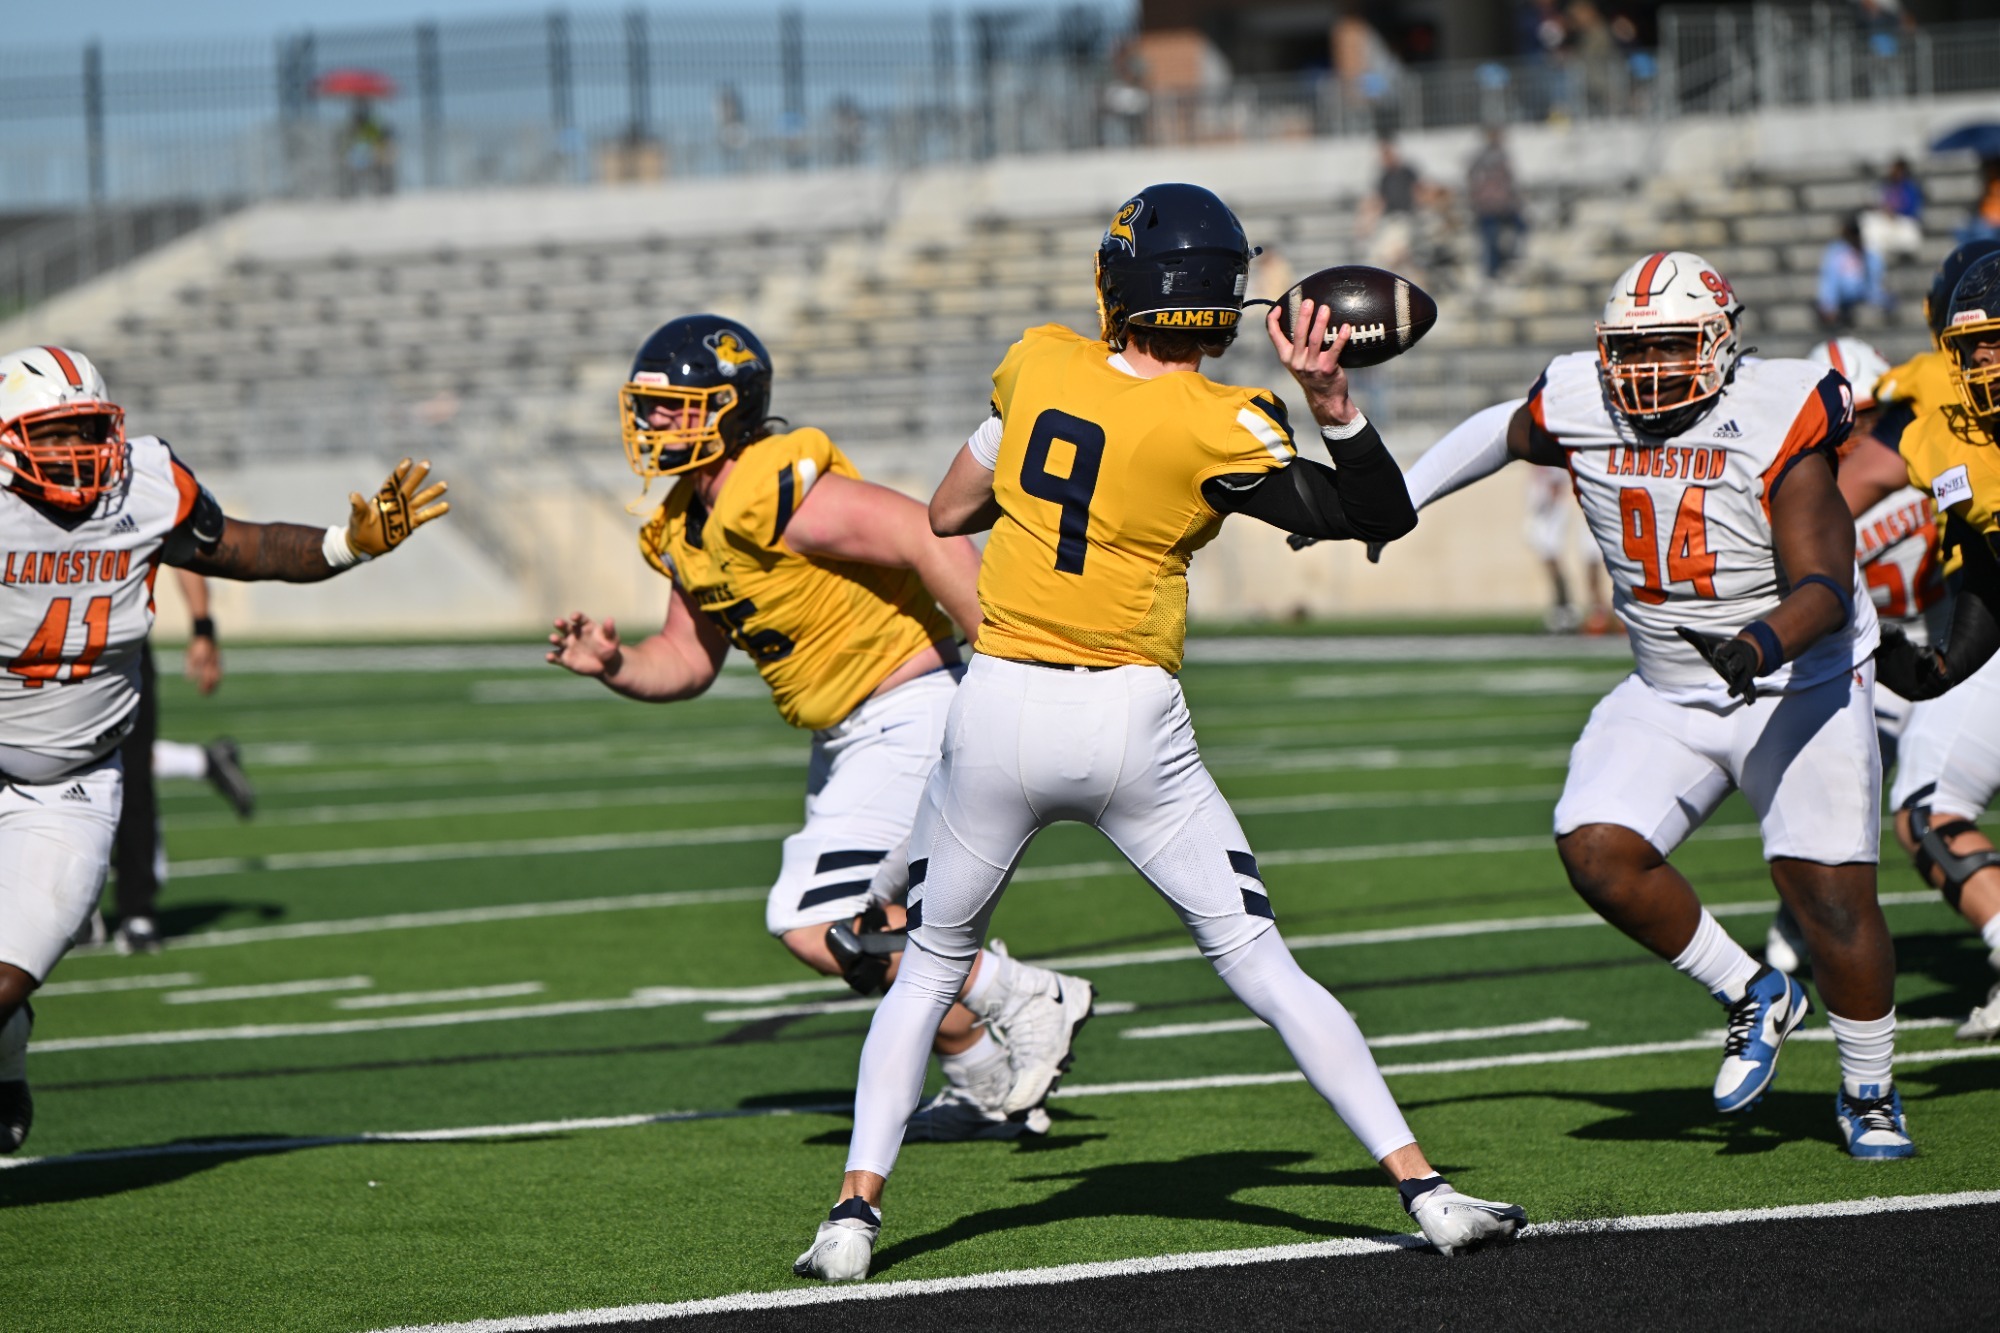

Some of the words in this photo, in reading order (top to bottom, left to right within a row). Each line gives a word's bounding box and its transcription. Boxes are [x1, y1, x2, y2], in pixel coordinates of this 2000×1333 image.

[1700, 269, 1738, 308] 9
[1155, 310, 1214, 327] RAMS
[1218, 311, 1238, 326] UP
[1607, 445, 1728, 481] LANGSTON
[1020, 408, 1106, 576] 9
[1618, 486, 1719, 606] 94
[4, 550, 132, 585] LANGSTON
[7, 595, 113, 689] 41
